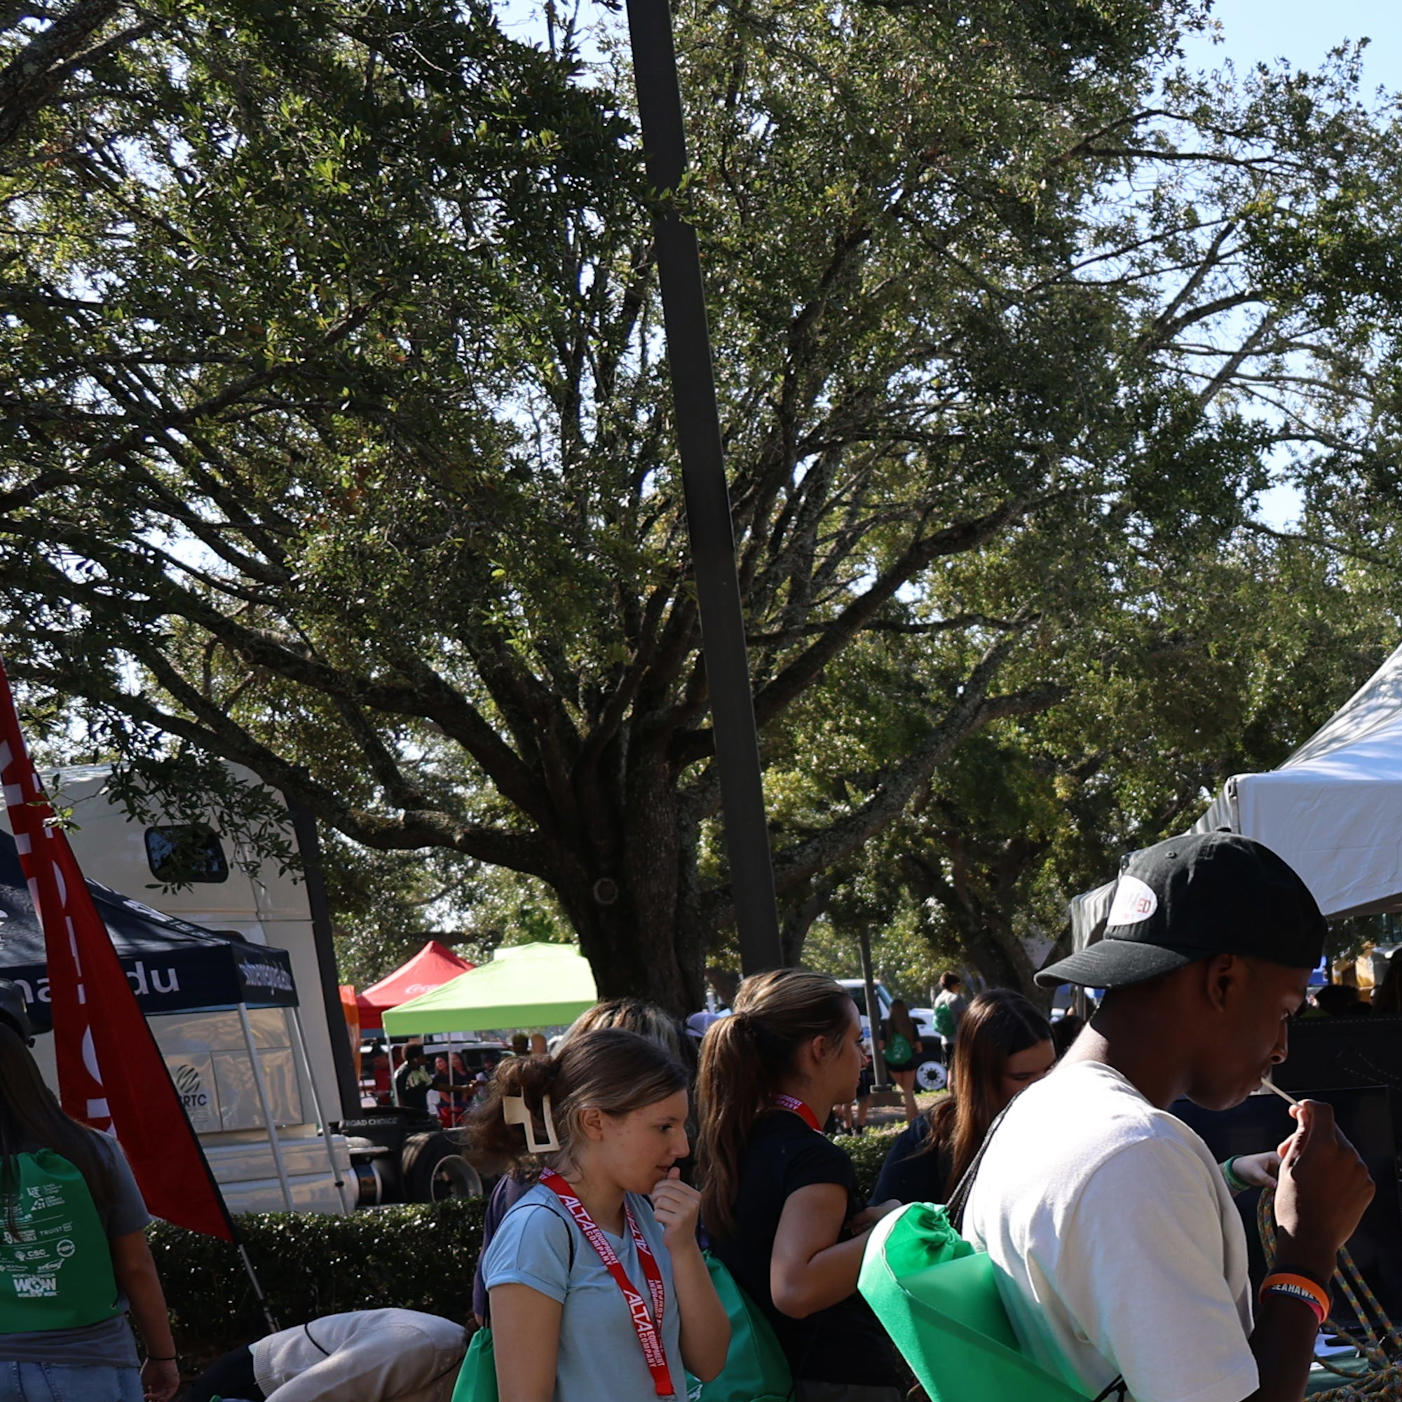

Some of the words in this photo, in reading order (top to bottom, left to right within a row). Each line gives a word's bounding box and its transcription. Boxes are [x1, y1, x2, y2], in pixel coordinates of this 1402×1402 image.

[559, 1194, 598, 1232] ALTA
[27, 1249, 47, 1258] CSC
[586, 1230, 612, 1266] COMPANY
[592, 1228, 619, 1264] EQUIPMENT
[623, 1290, 653, 1333] ALTA
[638, 1332, 656, 1367] COMPANY
[646, 1330, 666, 1366] EQUIPMENT
